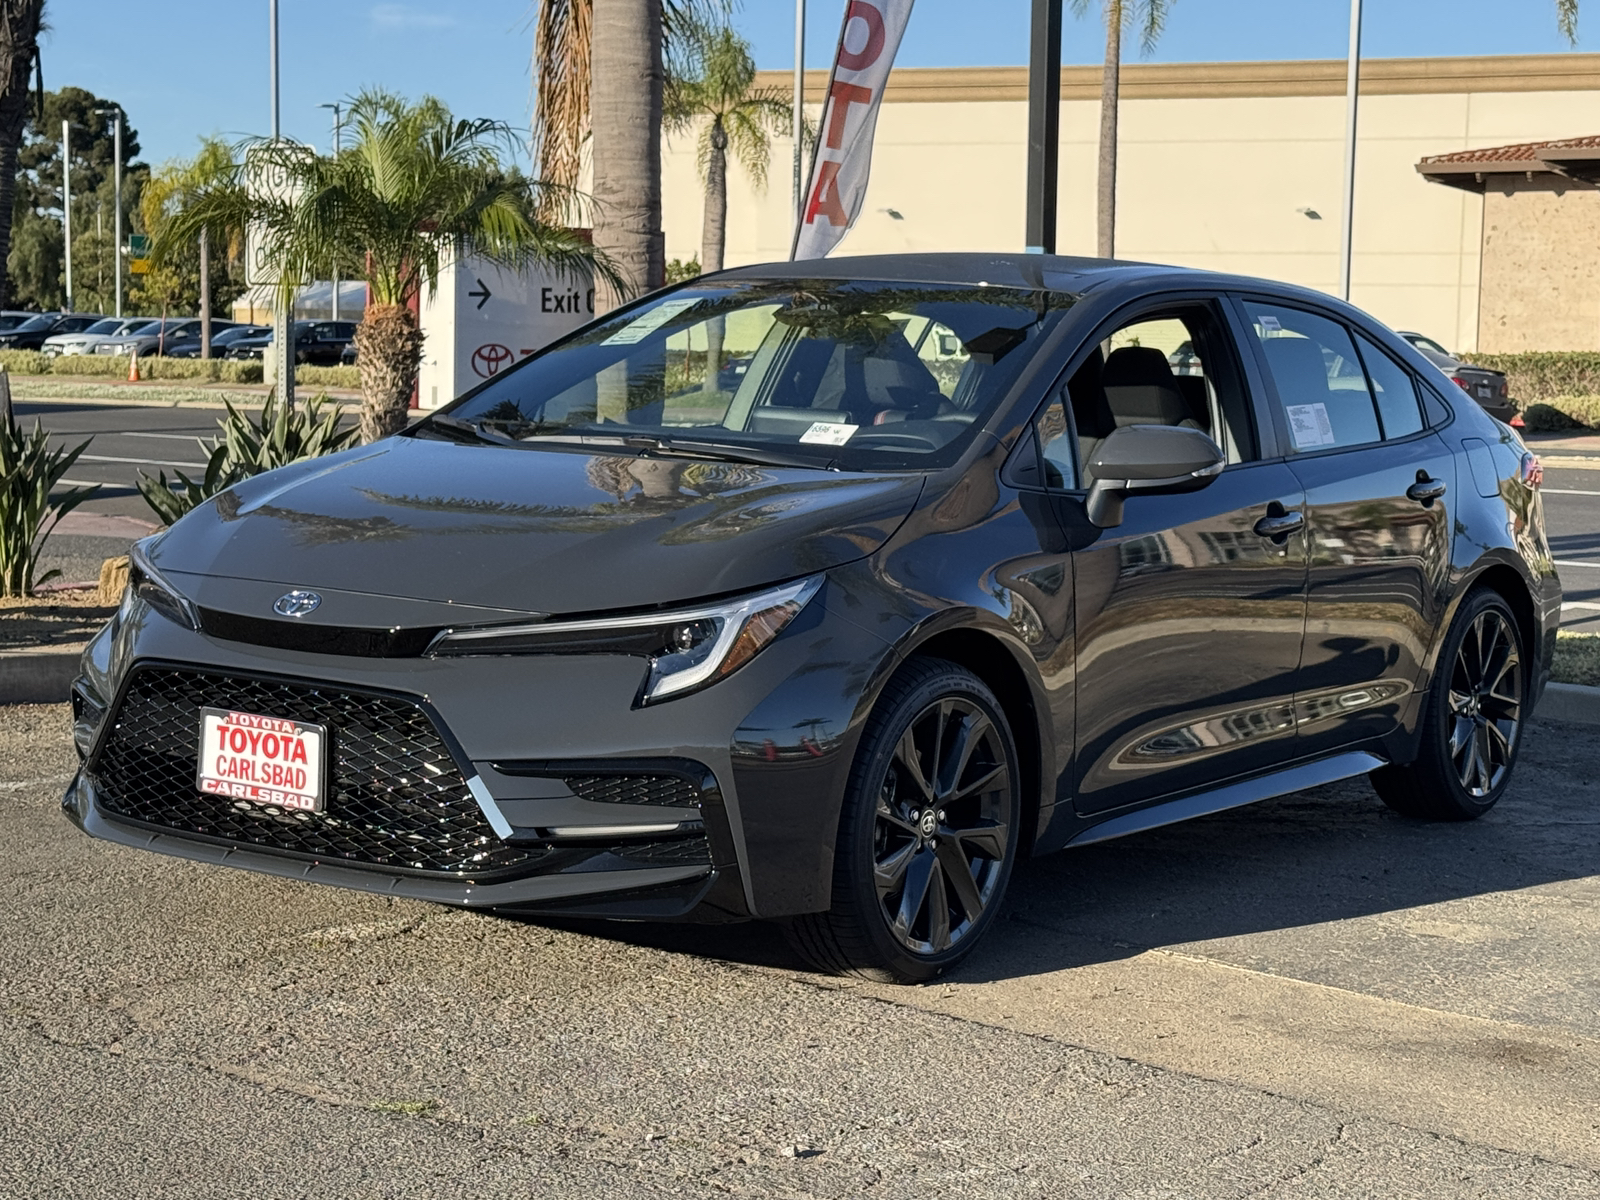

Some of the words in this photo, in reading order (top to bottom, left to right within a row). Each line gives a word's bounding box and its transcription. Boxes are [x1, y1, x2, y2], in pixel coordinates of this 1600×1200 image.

[541, 287, 581, 314] Exit
[229, 712, 295, 734] TOYOTA
[216, 724, 308, 765] TOYOTA
[216, 754, 307, 790] CARLSBAD
[201, 778, 315, 811] CARLSBAD
